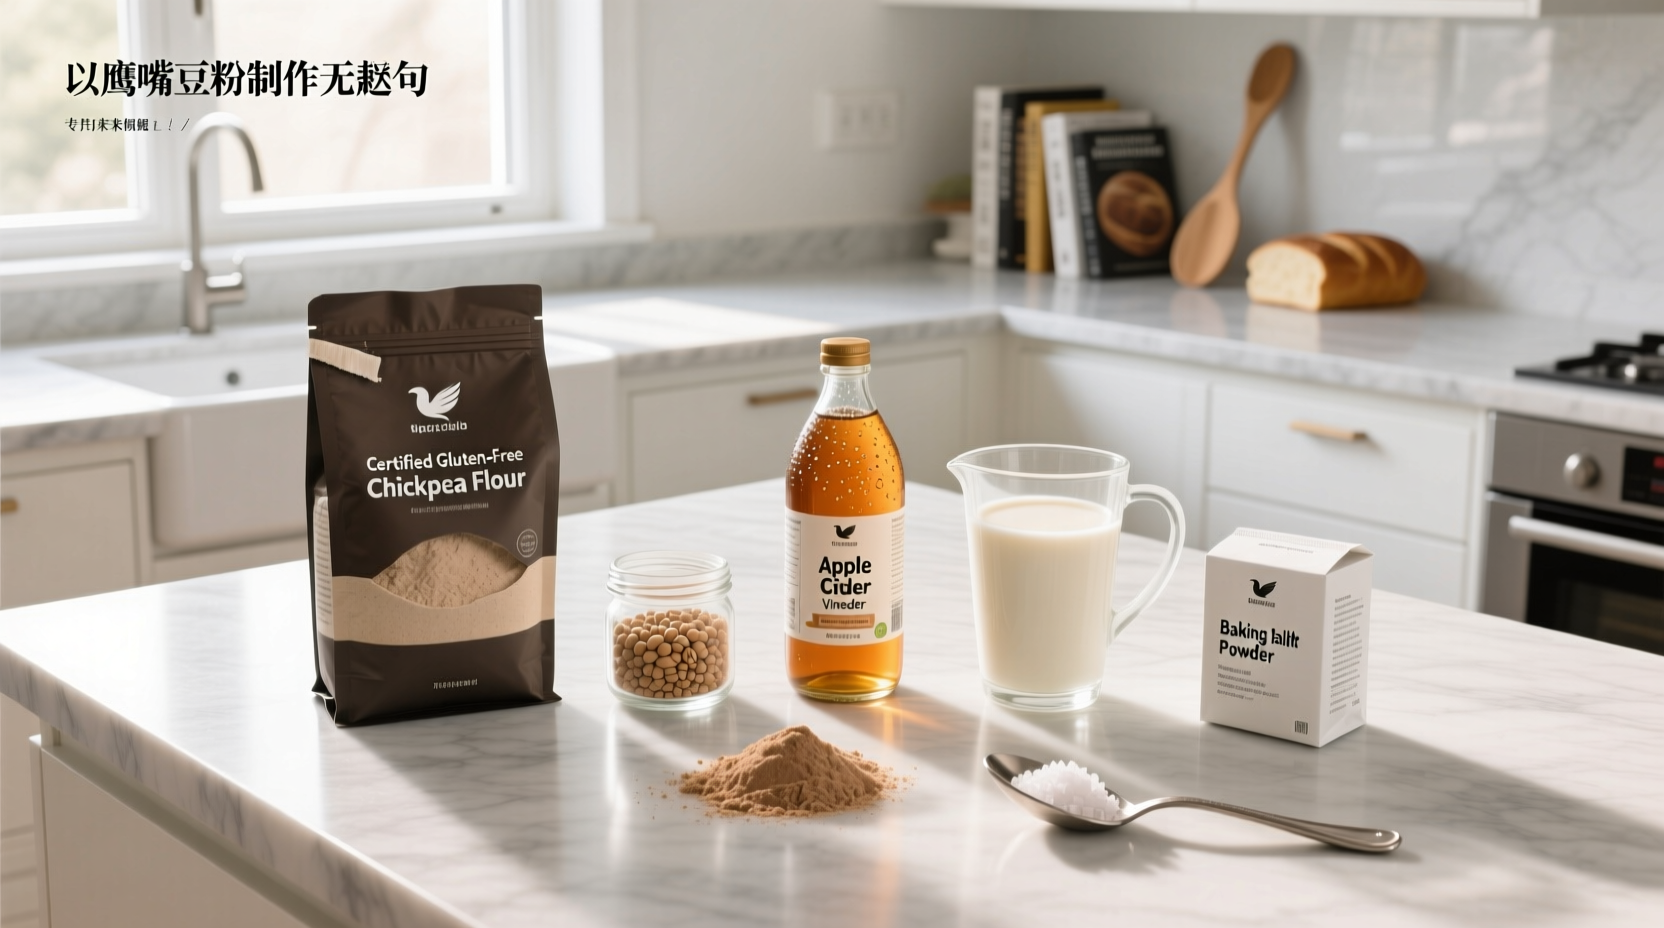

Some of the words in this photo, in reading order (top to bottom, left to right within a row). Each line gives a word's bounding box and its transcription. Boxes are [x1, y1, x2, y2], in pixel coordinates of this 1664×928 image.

[366, 452, 433, 472] Certified
[436, 448, 524, 469] Gluten-Free
[366, 475, 468, 502] Chickpea
[471, 470, 527, 492] Flour
[818, 556, 872, 578] Apple
[820, 577, 872, 596] Cider
[1220, 619, 1268, 647] Baking
[1219, 640, 1275, 664] Powder
